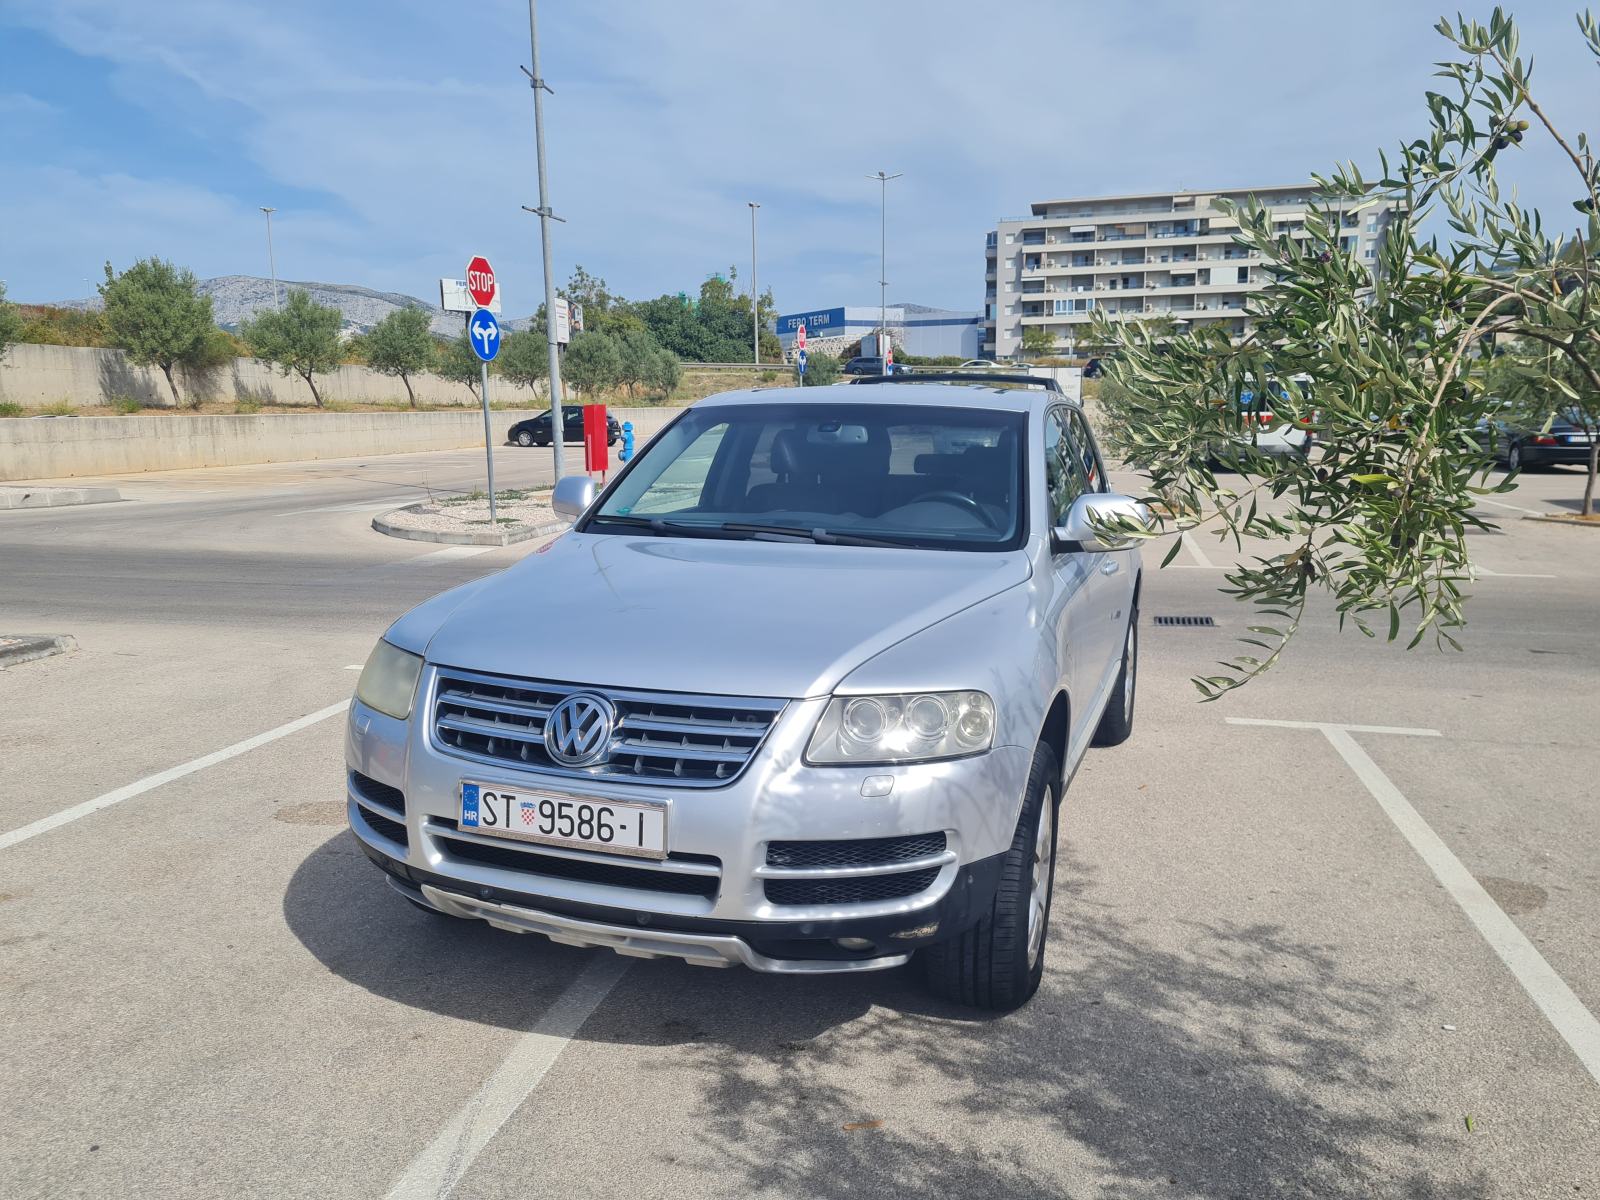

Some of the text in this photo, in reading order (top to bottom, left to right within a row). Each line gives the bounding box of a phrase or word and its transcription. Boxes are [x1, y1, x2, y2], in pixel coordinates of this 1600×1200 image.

[469, 270, 494, 292] STOP
[788, 314, 830, 328] FERO TERM
[553, 697, 607, 760] VW
[464, 810, 477, 821] HR
[482, 791, 516, 828] ST
